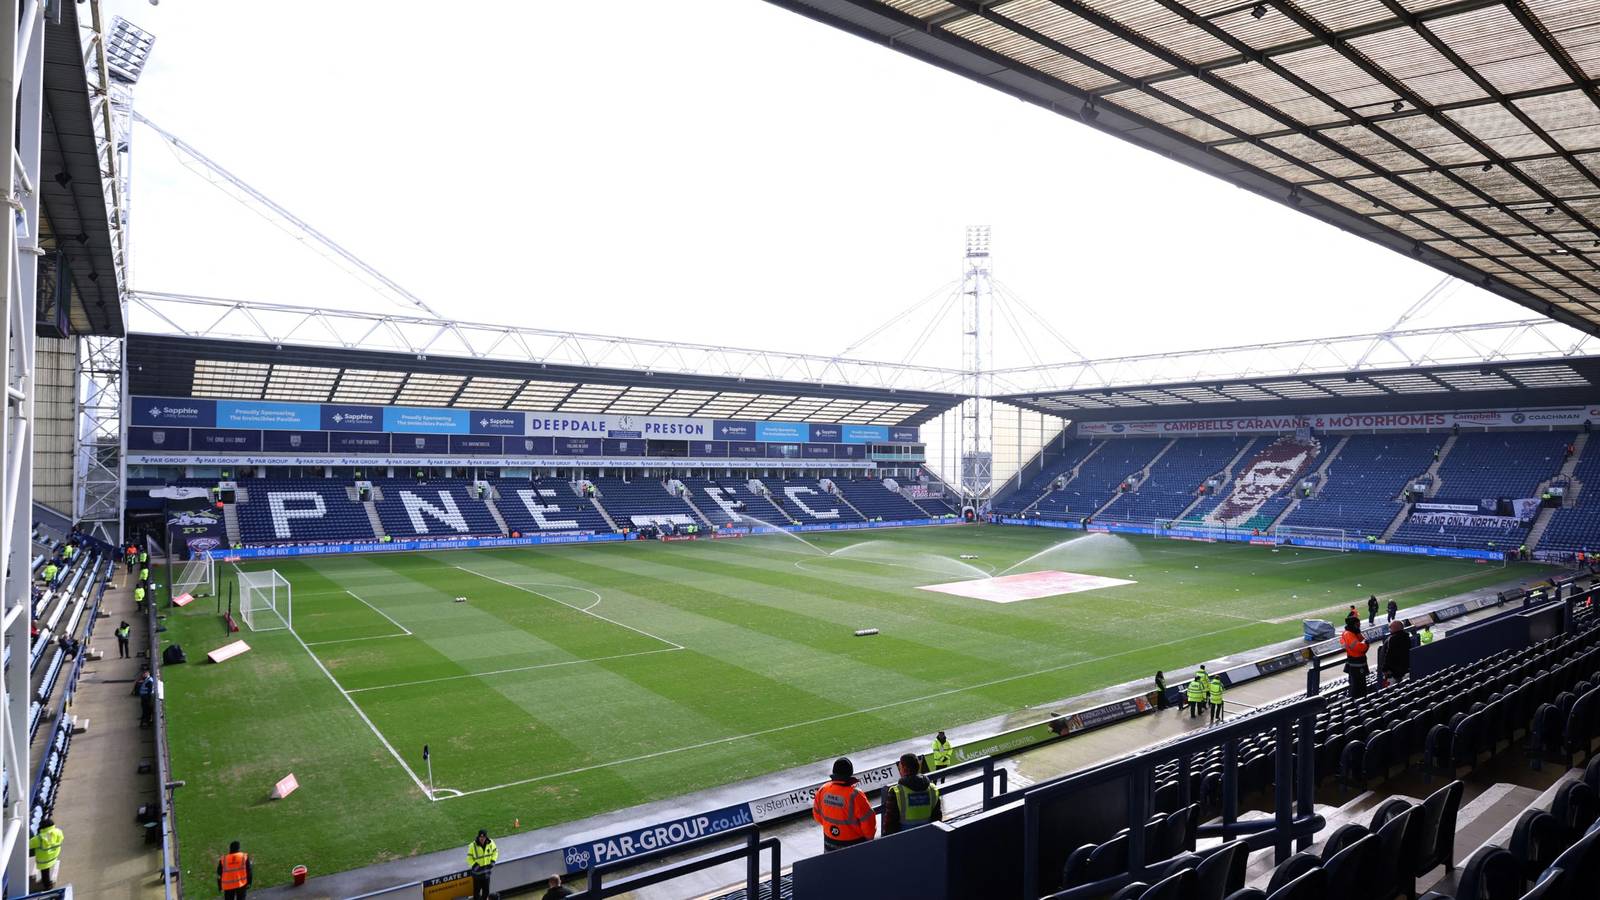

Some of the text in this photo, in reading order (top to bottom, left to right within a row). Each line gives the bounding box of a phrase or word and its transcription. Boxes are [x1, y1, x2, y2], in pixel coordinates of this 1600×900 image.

[163, 406, 198, 415] Sapphire
[344, 413, 373, 421] Sapphire
[1452, 411, 1502, 421] Campbells
[532, 419, 606, 431] DEEPDALE
[645, 422, 704, 435] PRESTON
[1164, 414, 1446, 431] CAMPBELLS CARAVANS & MOTORHOMES
[1410, 514, 1520, 529] ONE AND ONLY NORTH END
[374, 543, 407, 551] MORISSETTE
[541, 535, 589, 544] LYTHAMFESTIVAL.COM
[963, 745, 999, 760] LANCASHIRE
[593, 808, 751, 862] PAR-GROUP.co.uk
[443, 873, 462, 883] GATE
